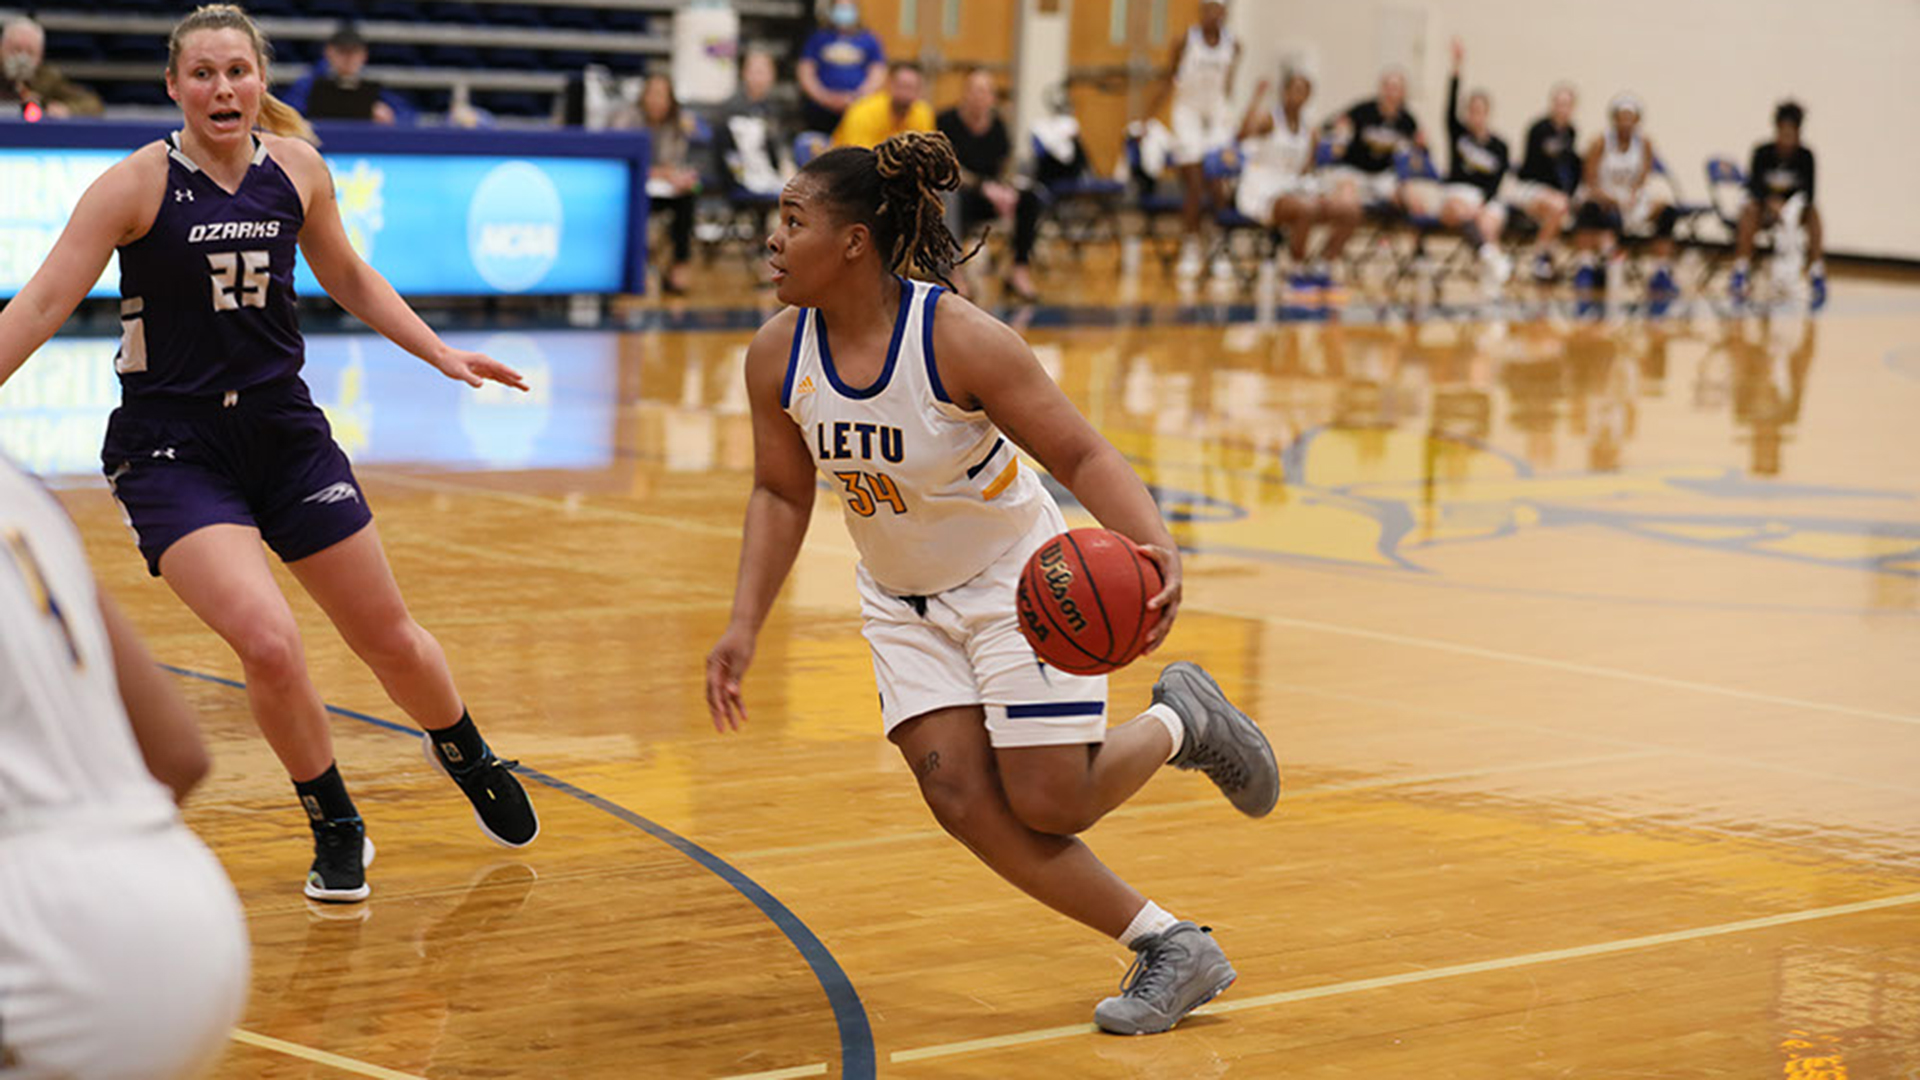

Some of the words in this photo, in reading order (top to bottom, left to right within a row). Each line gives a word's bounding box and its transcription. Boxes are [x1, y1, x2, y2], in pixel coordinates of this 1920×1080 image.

[187, 219, 281, 244] OZARKS
[206, 250, 271, 313] 25
[817, 421, 904, 464] LETU
[833, 471, 908, 517] 34
[1040, 541, 1087, 635] Wilson
